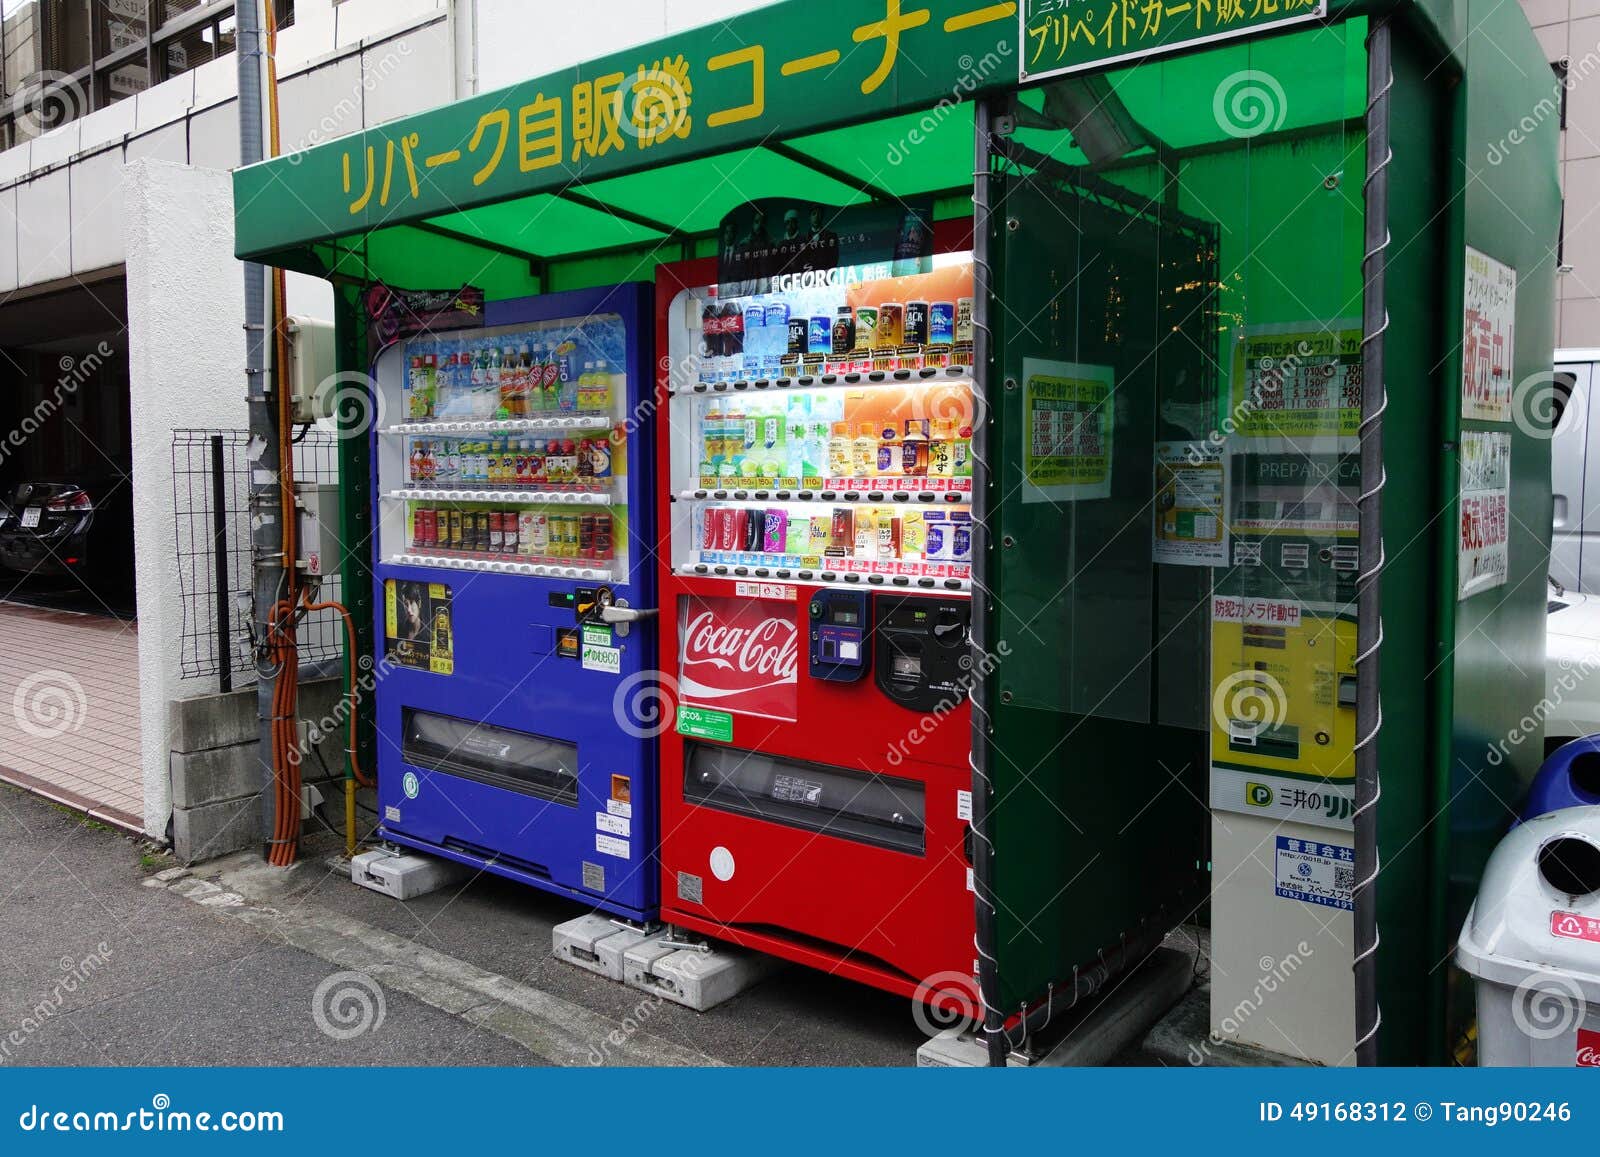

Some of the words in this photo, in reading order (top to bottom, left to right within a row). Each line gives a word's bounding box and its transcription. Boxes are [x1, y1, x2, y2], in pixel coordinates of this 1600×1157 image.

[1029, 0, 1314, 64] プリペイドカード販
[343, 0, 1016, 214] リパーク自販機コーナー
[780, 265, 858, 293] GEORGIA
[1259, 462, 1329, 479] PREPAID
[1215, 600, 1299, 622] 防犯カメラ作動中
[1288, 839, 1353, 862] 管理会社
